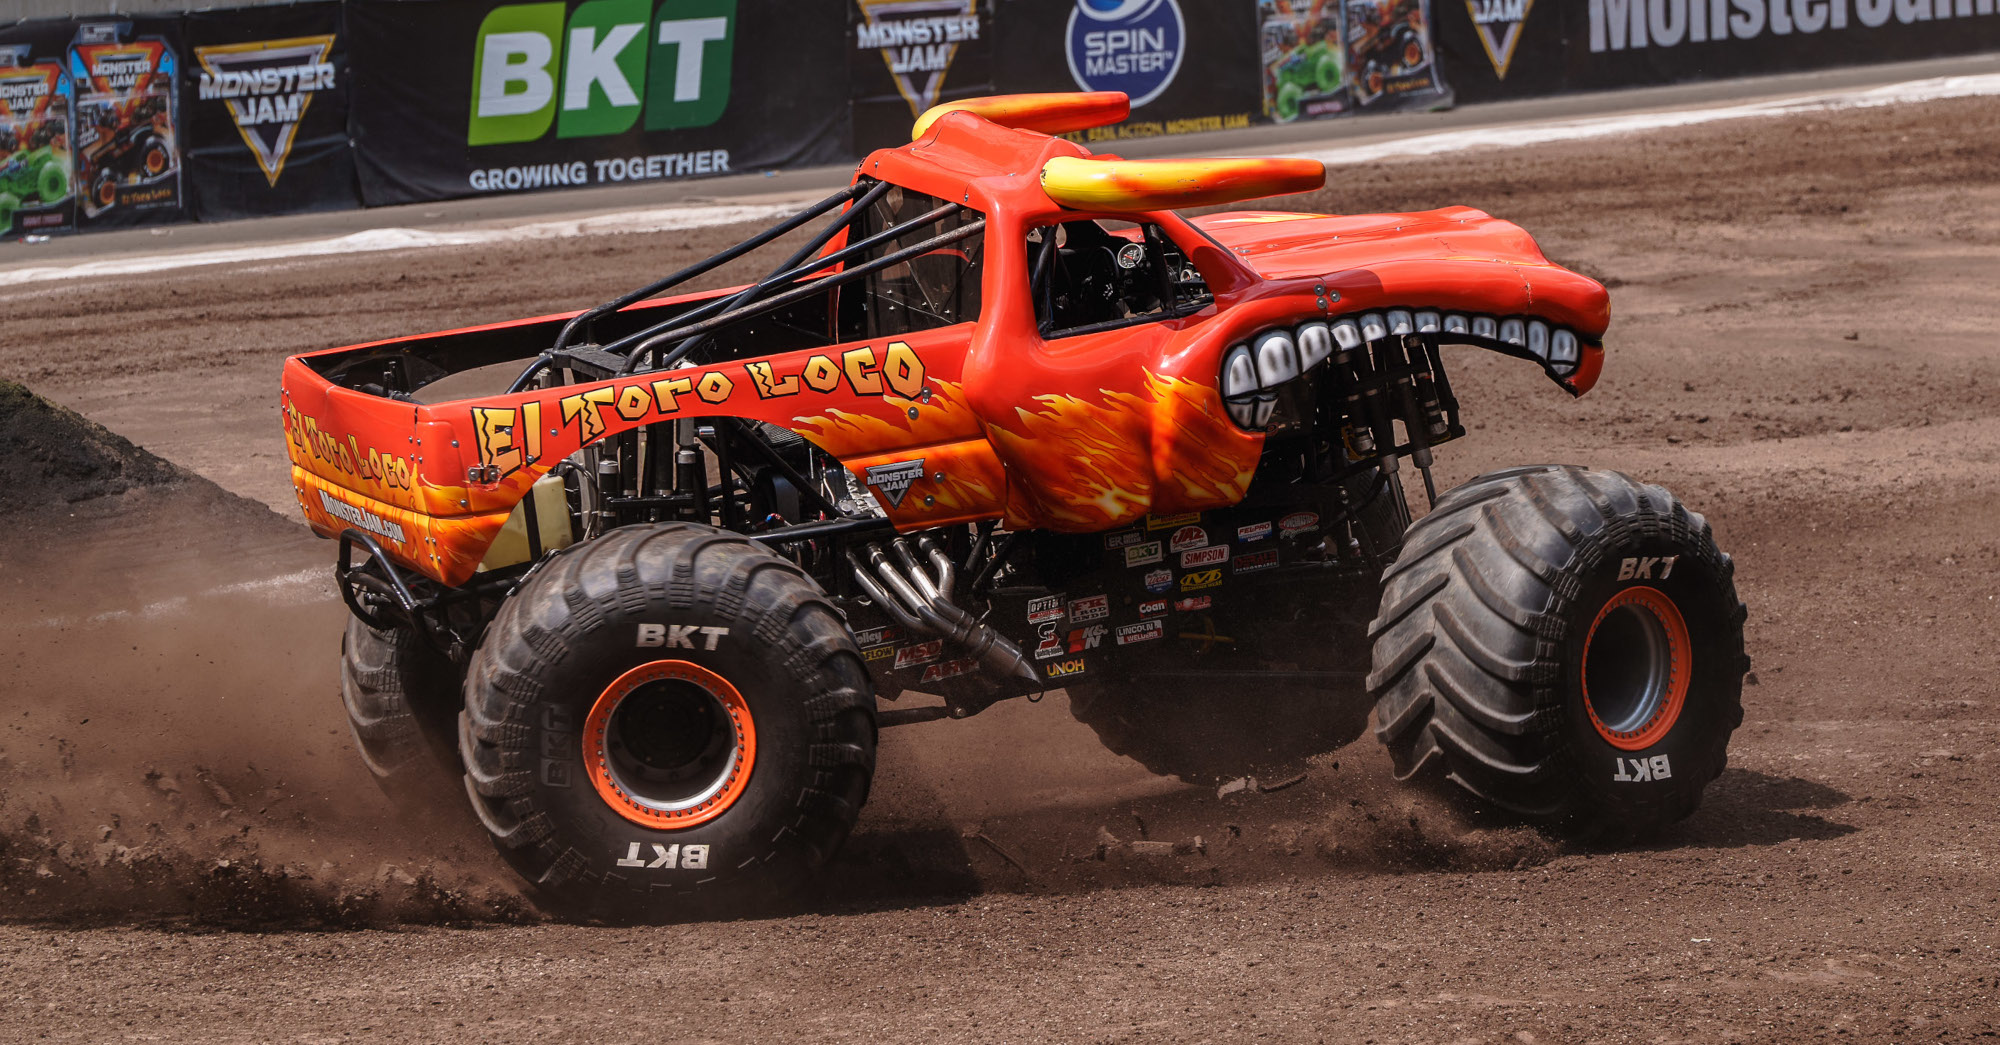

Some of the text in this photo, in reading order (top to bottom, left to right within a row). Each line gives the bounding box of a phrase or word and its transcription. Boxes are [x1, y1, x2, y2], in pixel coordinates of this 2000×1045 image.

[858, 15, 980, 49] MONSTER
[1589, 0, 1994, 52] Monste
[1085, 27, 1164, 55] SPIN
[477, 17, 728, 118] BKT
[894, 42, 949, 74] JAM
[92, 60, 152, 78] MONSTER
[109, 75, 136, 88] JAM
[199, 62, 336, 100] MONSTER
[8, 97, 35, 111] JAM
[238, 95, 300, 127] JAM
[469, 149, 730, 191] GROWING TOGETHER
[560, 371, 734, 445] Toro
[866, 467, 924, 486] MONSTER
[882, 480, 909, 492] JAM
[1172, 527, 1205, 545] JAZ
[1129, 543, 1158, 560] BKT
[1185, 548, 1225, 565] SIMPSON
[1616, 554, 1680, 581] BKT
[1072, 612, 1107, 621] ENDS
[1080, 607, 1106, 616] ROD
[1139, 602, 1165, 613] Coan
[635, 623, 730, 651] BKT
[855, 631, 882, 645] olley
[1119, 623, 1153, 637] LINCOLN
[1126, 631, 1158, 643] WELDERS
[861, 647, 893, 660] FLOW
[897, 641, 942, 663] MSD
[1047, 659, 1085, 677] UNOH
[545, 705, 570, 786] BKT
[1613, 754, 1672, 783] BKT
[617, 841, 710, 869] BKT
